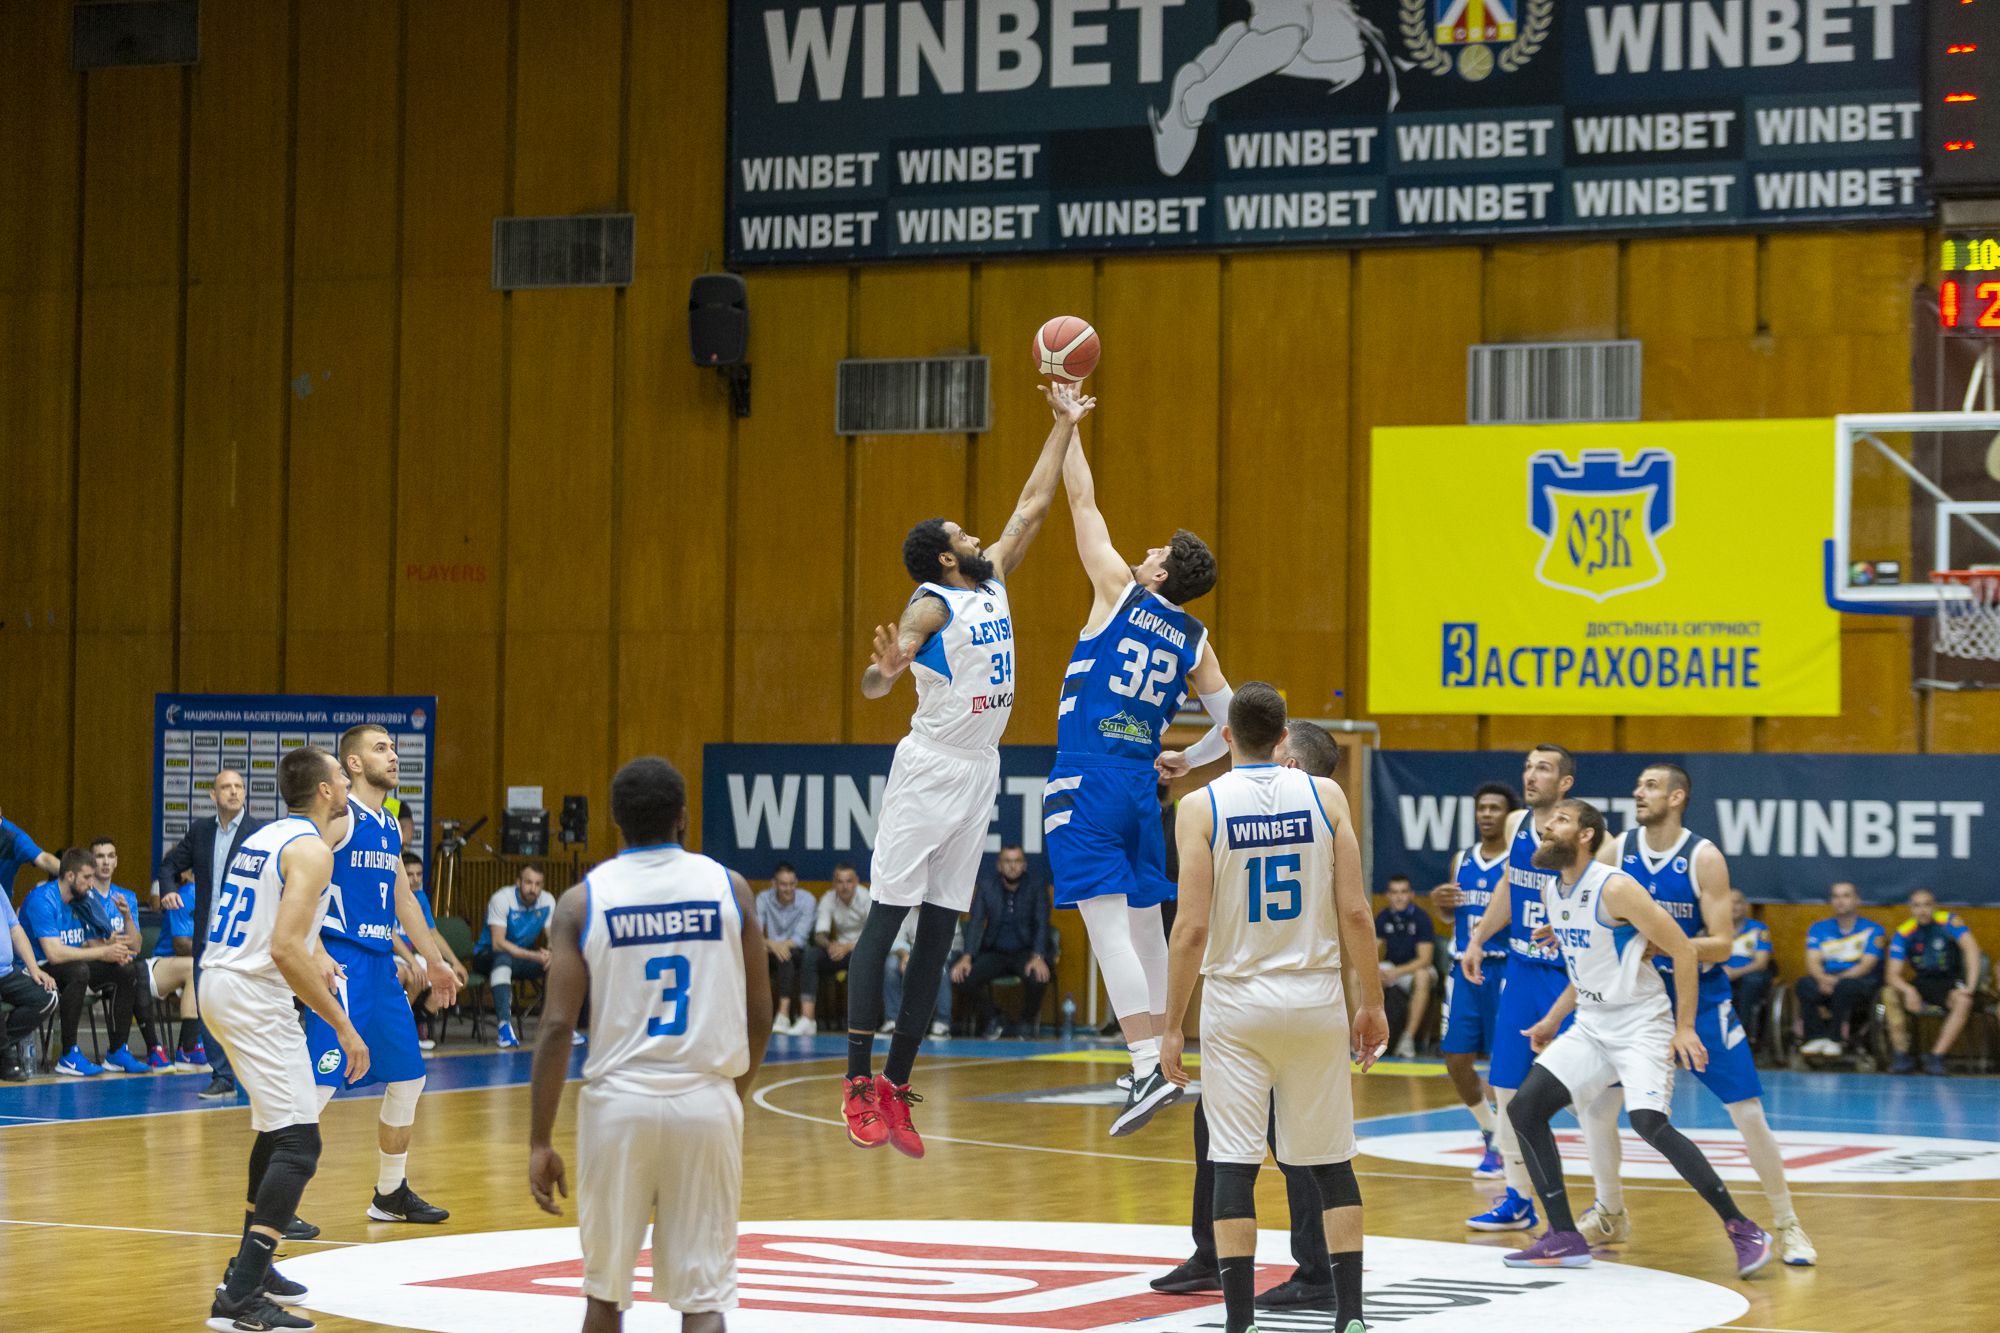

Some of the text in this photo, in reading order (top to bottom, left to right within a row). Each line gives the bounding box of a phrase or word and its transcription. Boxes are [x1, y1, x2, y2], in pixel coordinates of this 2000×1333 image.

[763, 0, 1185, 104] WINBET
[1586, 0, 1908, 75] WINBET
[1397, 120, 1554, 161] WINBET
[1573, 111, 1735, 154] WINBET
[1755, 103, 1922, 145] WINBET
[898, 144, 1040, 184] WINBET
[1225, 128, 1378, 169] WINBET
[741, 152, 880, 191] WINBET
[1755, 168, 1922, 210] WINBET
[1058, 197, 1206, 237] WINBET
[1224, 190, 1377, 230] WINBET
[1396, 183, 1554, 224] WINBET
[1573, 176, 1735, 217] WINBET
[740, 212, 879, 250] WINBET
[897, 205, 1039, 244] WINBET
[990, 651, 1012, 685] 34
[1109, 638, 1178, 707] 32
[727, 774, 1049, 854] WINT
[1232, 817, 1307, 842] WINBET
[1715, 799, 1984, 859] WINBET
[351, 850, 364, 868] BC
[1244, 853, 1302, 922] 15
[209, 882, 256, 948] 32
[611, 908, 717, 939] WINBET
[1523, 900, 1545, 929] 12
[646, 954, 691, 1037] 3
